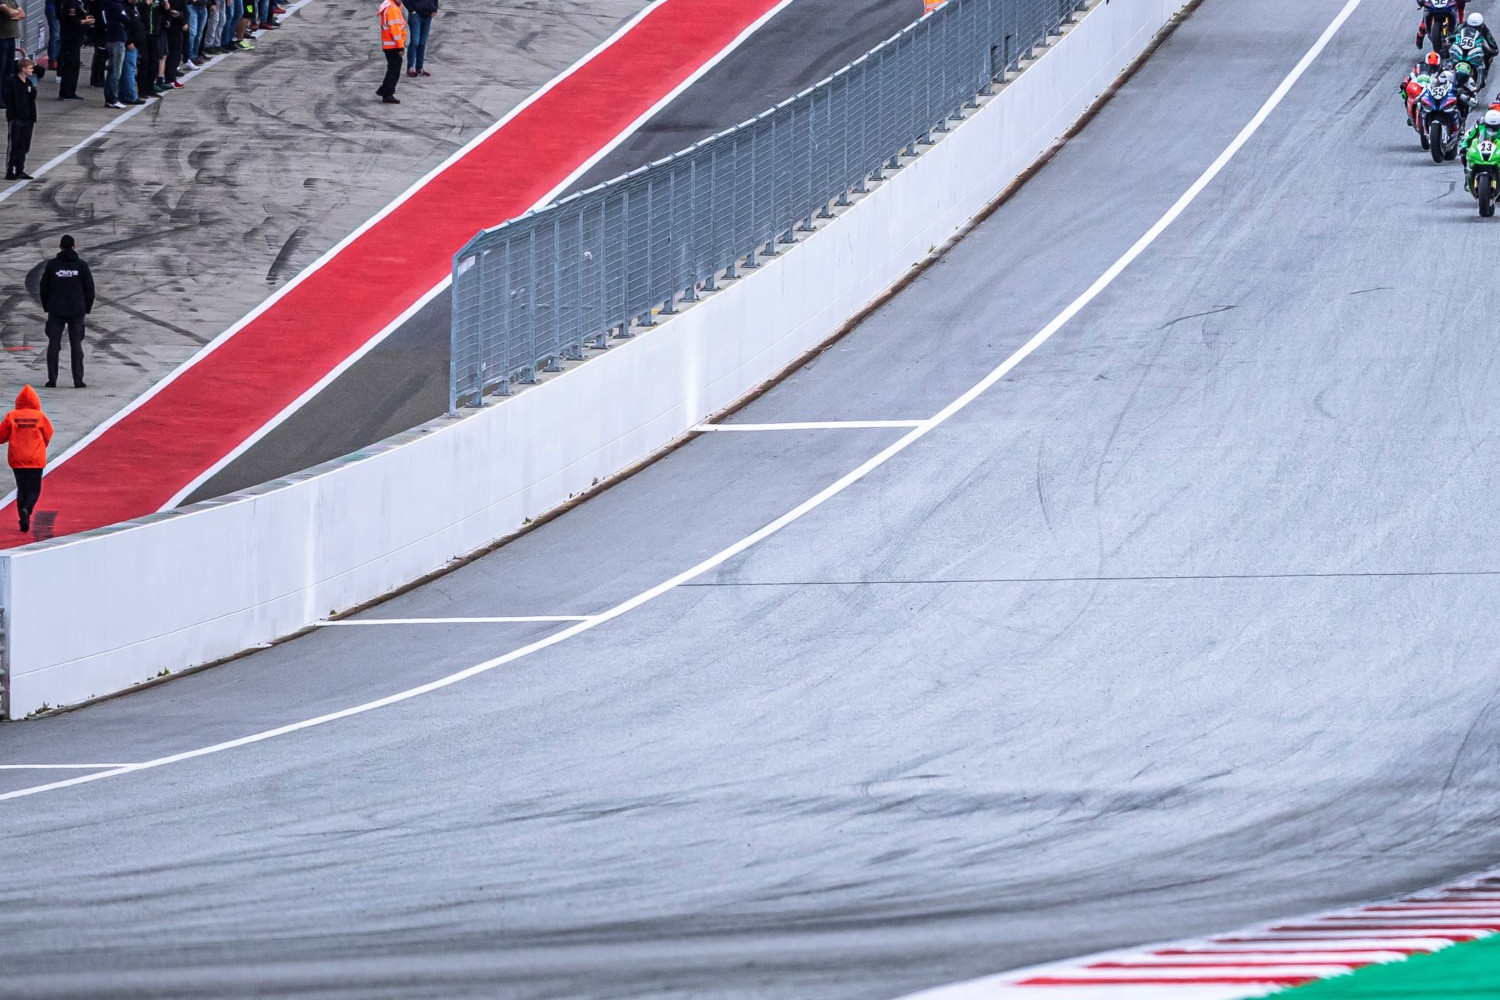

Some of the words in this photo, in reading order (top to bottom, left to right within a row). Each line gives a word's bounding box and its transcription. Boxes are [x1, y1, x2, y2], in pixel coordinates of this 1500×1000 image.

[1461, 38, 1474, 48] 56
[1432, 86, 1444, 97] 55
[1481, 143, 1492, 152] 23
